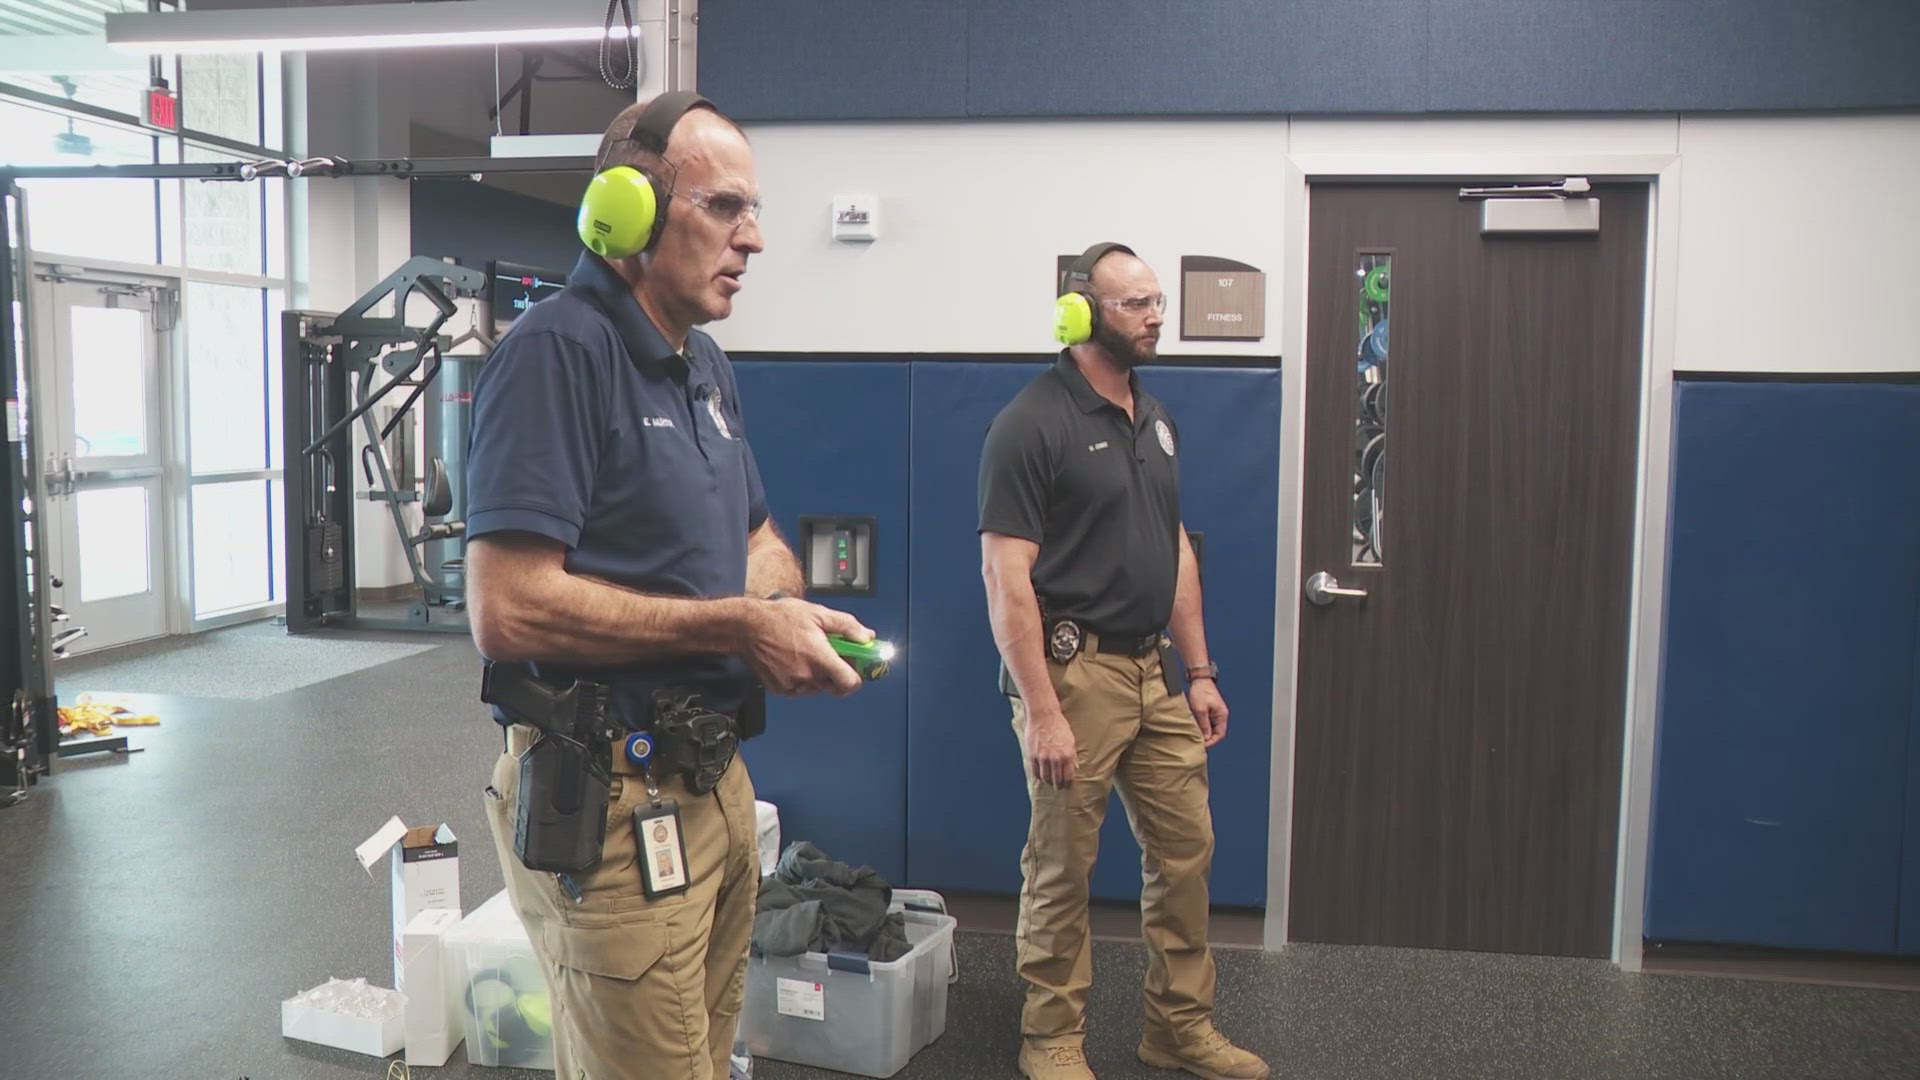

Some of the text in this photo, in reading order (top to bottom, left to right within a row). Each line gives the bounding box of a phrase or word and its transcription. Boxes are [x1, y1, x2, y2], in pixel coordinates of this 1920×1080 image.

[151, 92, 176, 130] EXIT
[1218, 278, 1234, 288] 107
[1207, 313, 1243, 322] FITNESS
